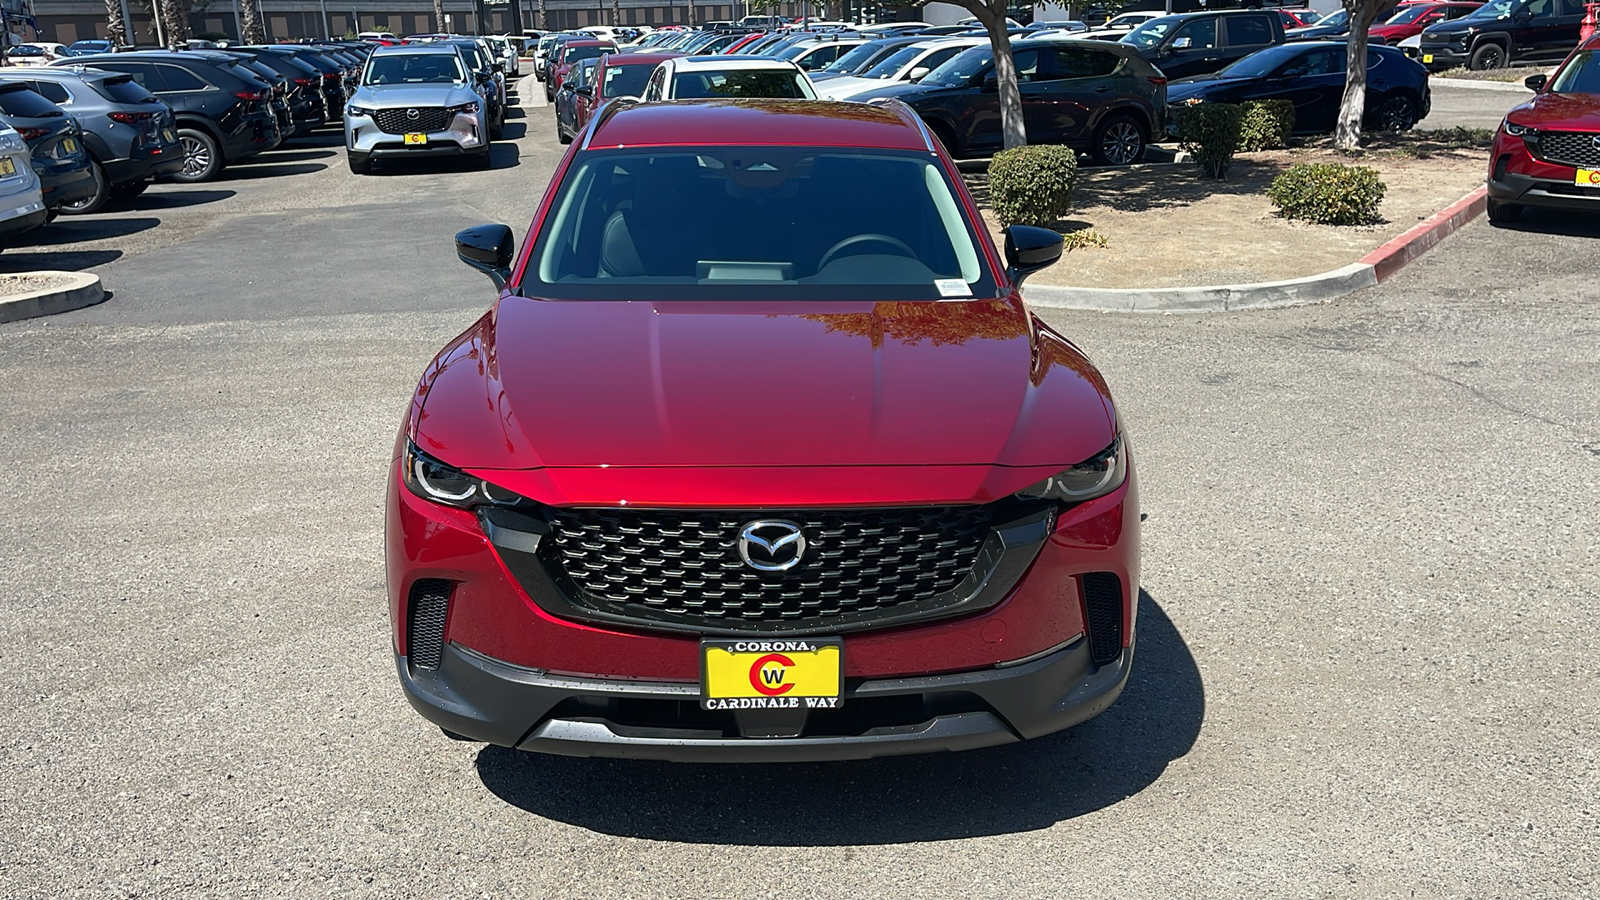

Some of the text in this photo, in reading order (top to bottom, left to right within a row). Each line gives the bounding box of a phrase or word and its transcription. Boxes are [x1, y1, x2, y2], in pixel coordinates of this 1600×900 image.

[735, 641, 810, 652] CORONA
[706, 697, 838, 710] CARDINALE WAY
